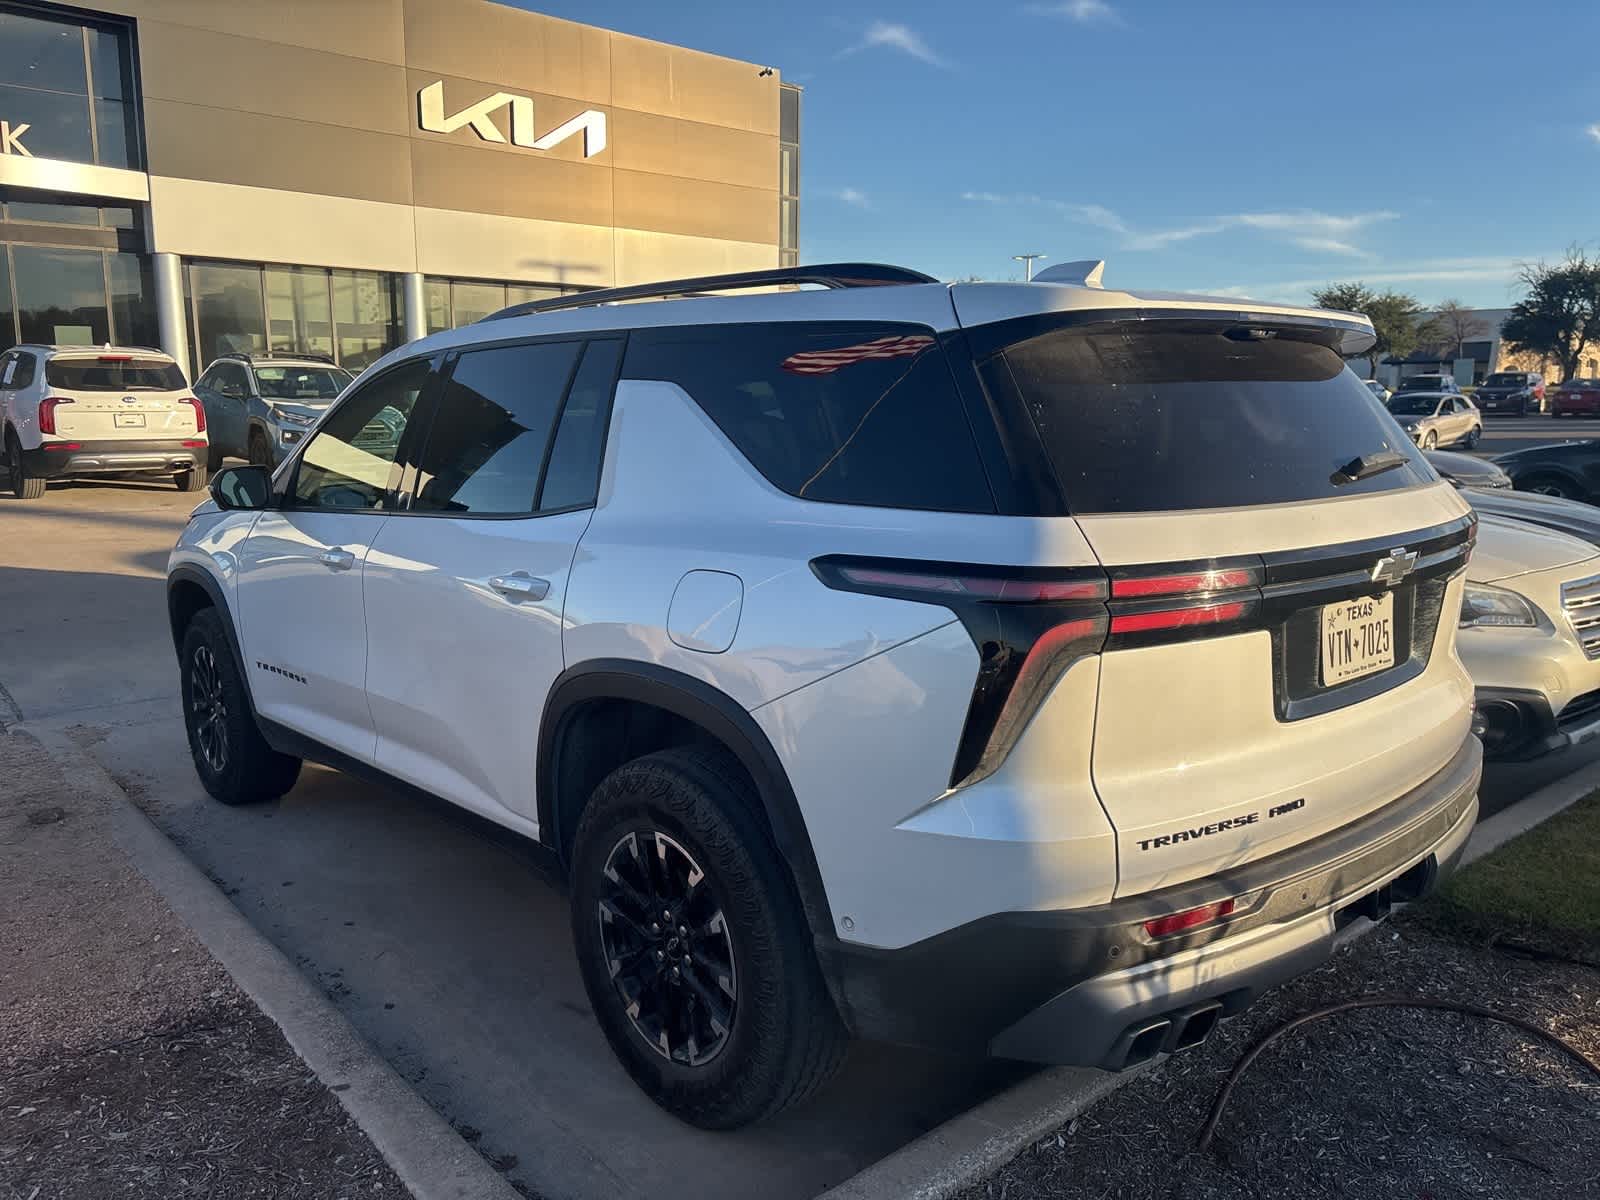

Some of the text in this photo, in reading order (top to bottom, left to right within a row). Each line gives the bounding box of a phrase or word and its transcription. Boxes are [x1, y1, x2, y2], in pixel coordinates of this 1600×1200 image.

[417, 79, 607, 159] KIA
[1346, 602, 1374, 621] TEXAS
[255, 660, 308, 685] TRAVERSE
[1136, 797, 1306, 851] TRAVERSE AWD
